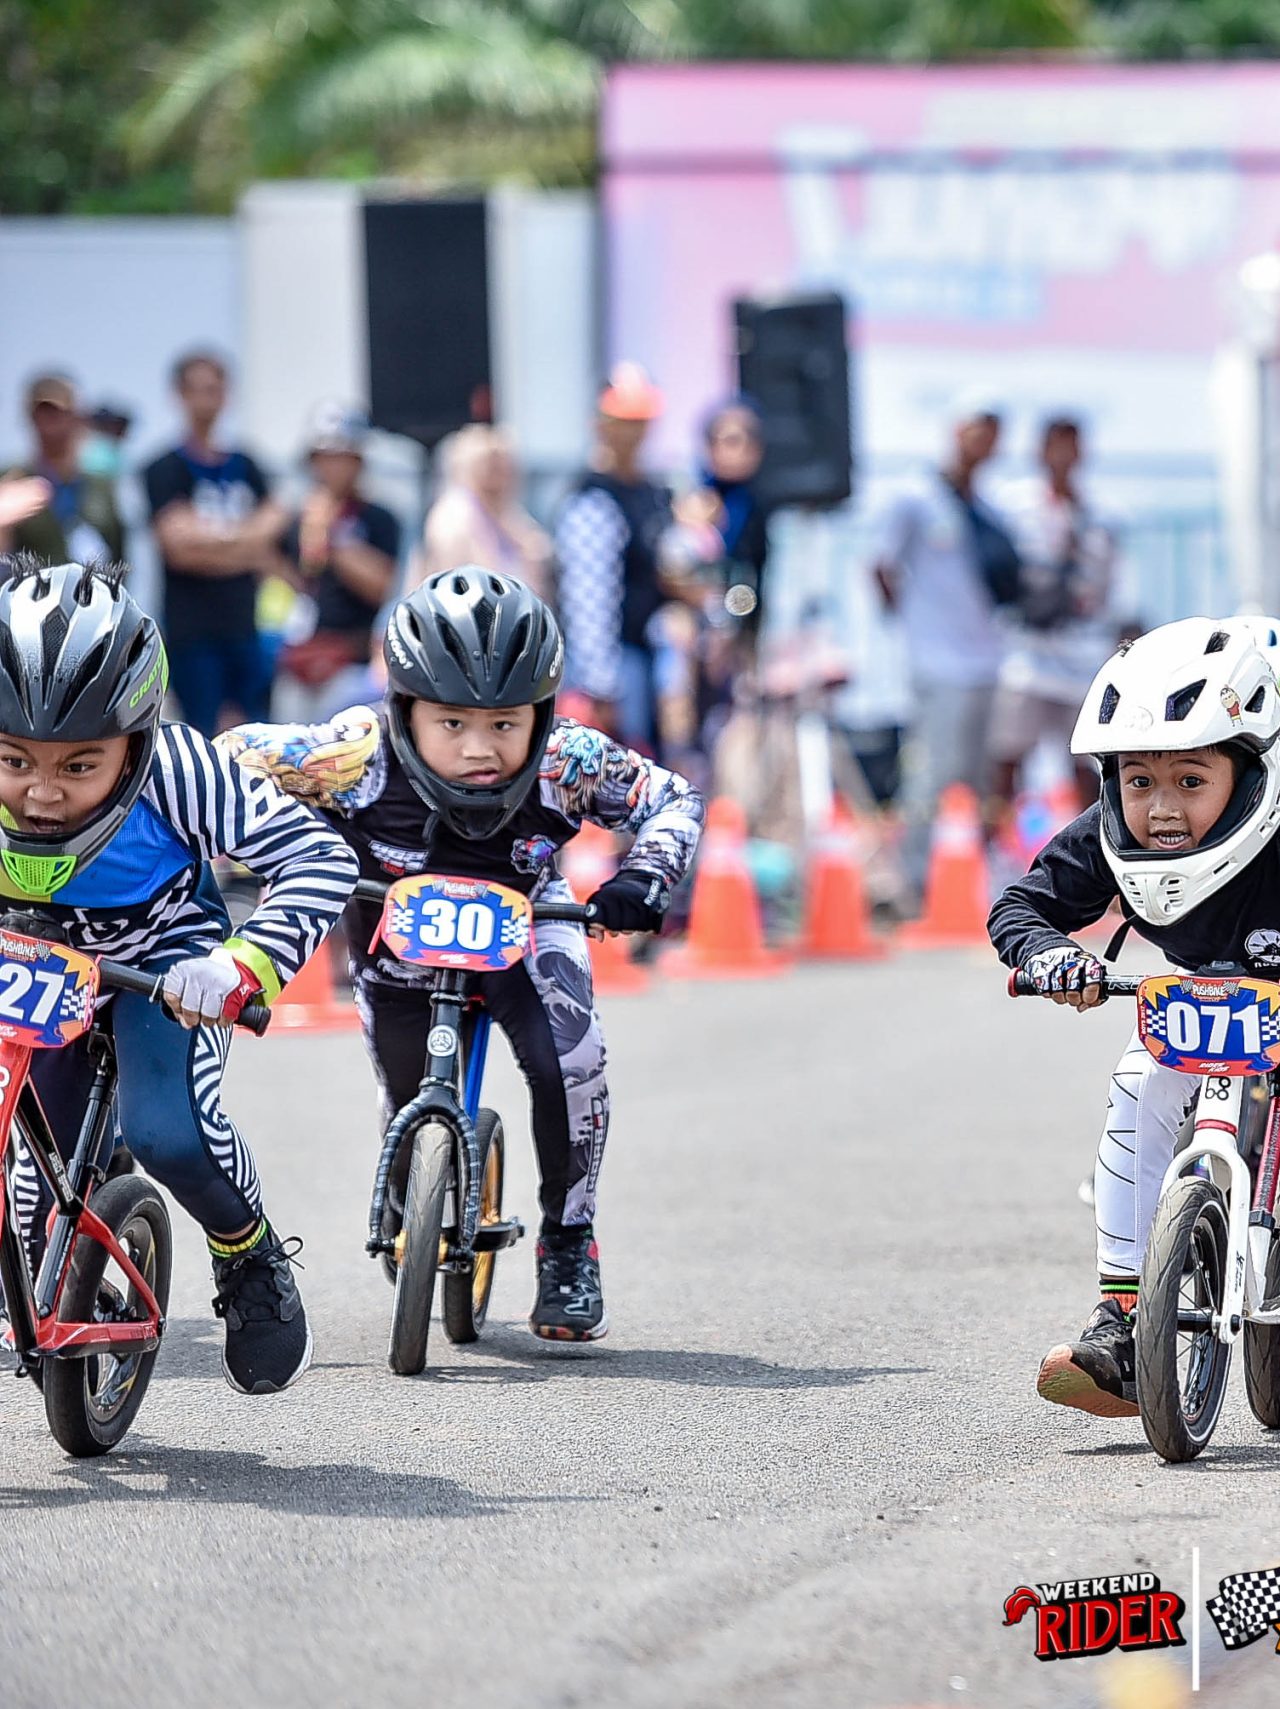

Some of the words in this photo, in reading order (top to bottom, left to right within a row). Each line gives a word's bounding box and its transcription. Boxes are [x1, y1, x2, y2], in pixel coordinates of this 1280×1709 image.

[419, 899, 494, 950] 30
[0, 962, 65, 1026] 27
[1166, 1001, 1261, 1054] 071
